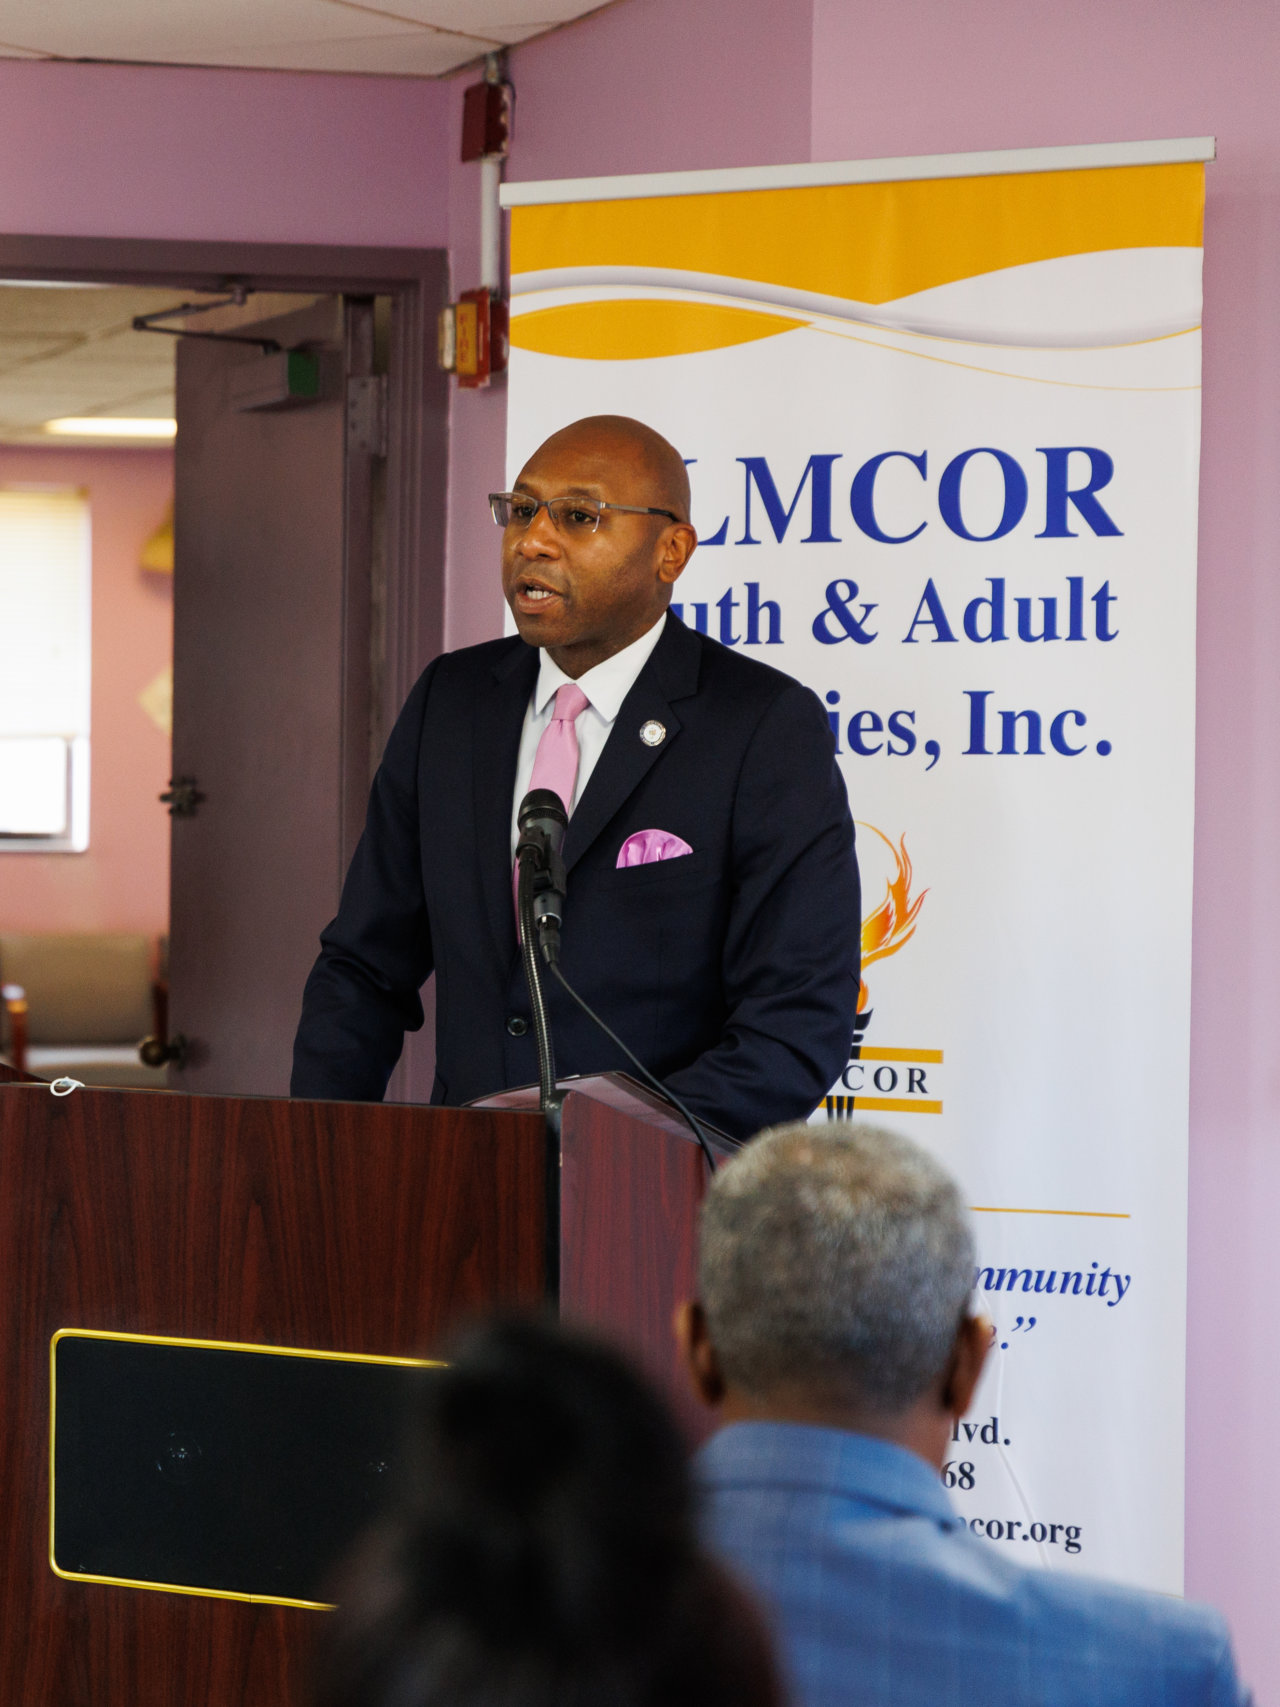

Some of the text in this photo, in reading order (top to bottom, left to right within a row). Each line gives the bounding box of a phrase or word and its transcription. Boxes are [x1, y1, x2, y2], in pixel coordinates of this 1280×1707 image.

[811, 578, 879, 646] &
[901, 576, 1120, 645] Adult
[826, 690, 1113, 772] ies, Inc.
[841, 1064, 930, 1094] COR
[941, 1461, 976, 1491] 68
[957, 1516, 1082, 1554] cor.org
